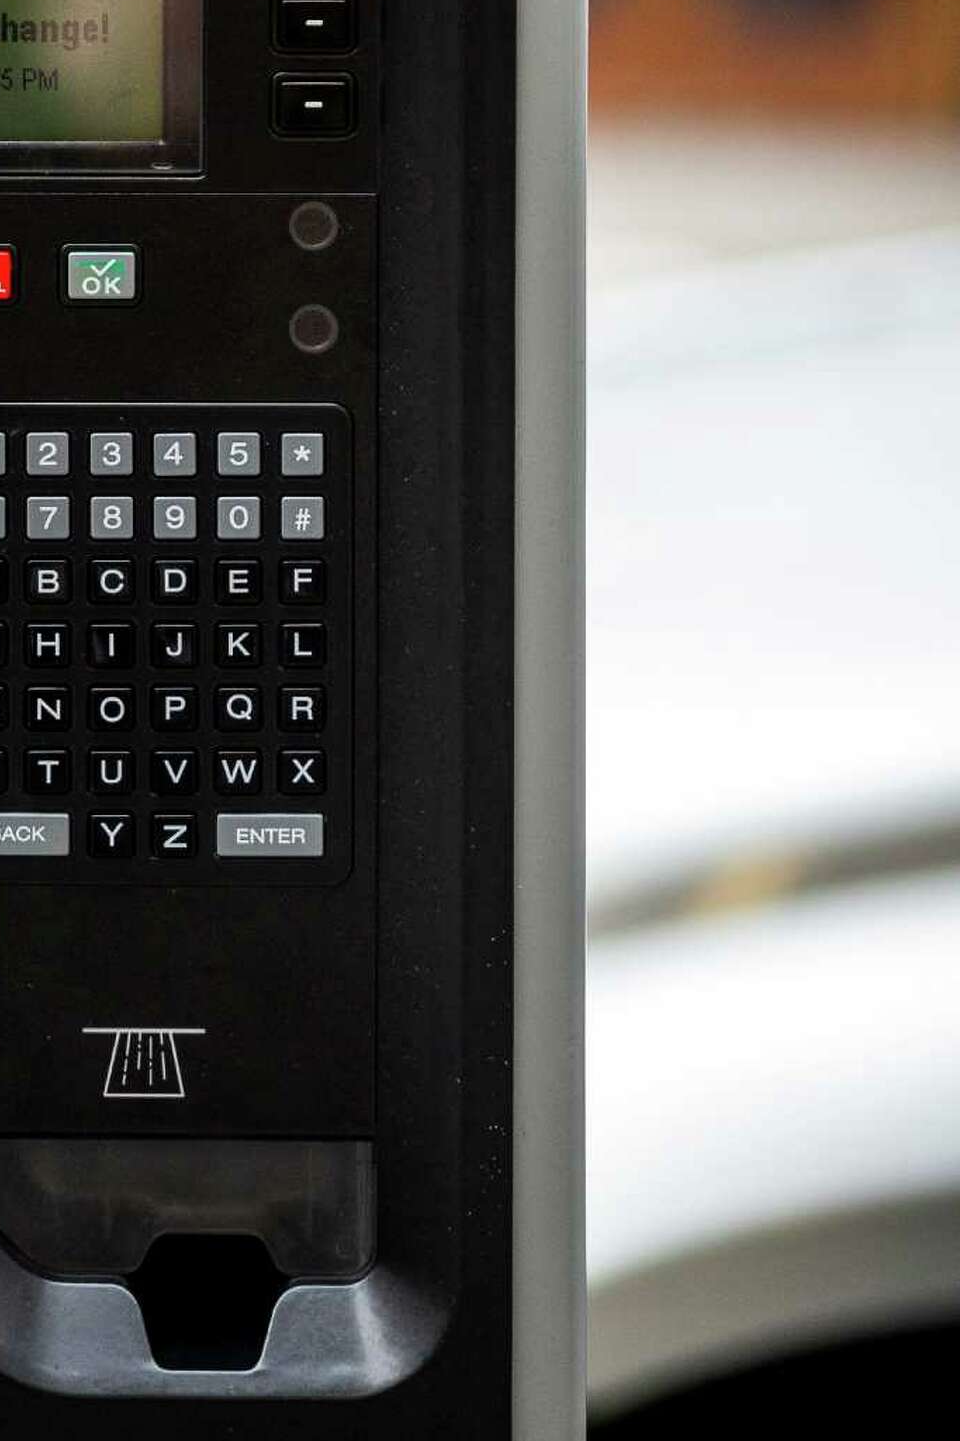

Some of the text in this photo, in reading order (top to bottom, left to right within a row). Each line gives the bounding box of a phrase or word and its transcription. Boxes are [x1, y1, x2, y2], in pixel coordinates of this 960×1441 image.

[22, 68, 58, 90] PM
[82, 278, 121, 294] OK
[39, 443, 57, 465] 2
[103, 442, 120, 465] 3
[164, 442, 183, 465] 4
[230, 442, 248, 465] 5
[40, 507, 57, 529] 7
[103, 506, 121, 529] 8
[166, 505, 184, 529] 9
[295, 508, 311, 530] #
[38, 570, 59, 593] B
[100, 570, 124, 593] C
[165, 569, 186, 592] D
[229, 570, 248, 593] E
[294, 569, 312, 592] F
[37, 633, 60, 656] H
[166, 633, 182, 656] J
[228, 632, 250, 656] K
[294, 632, 312, 656] L
[37, 698, 60, 720] N
[166, 696, 185, 720] P
[227, 694, 252, 720] Q
[292, 697, 313, 720] R
[38, 760, 59, 783] T
[101, 760, 122, 783] U
[165, 760, 187, 783] V
[222, 760, 256, 783] W
[293, 759, 314, 783] X
[101, 823, 123, 846] Y
[164, 825, 187, 848] Z
[237, 828, 305, 844] ENTER
